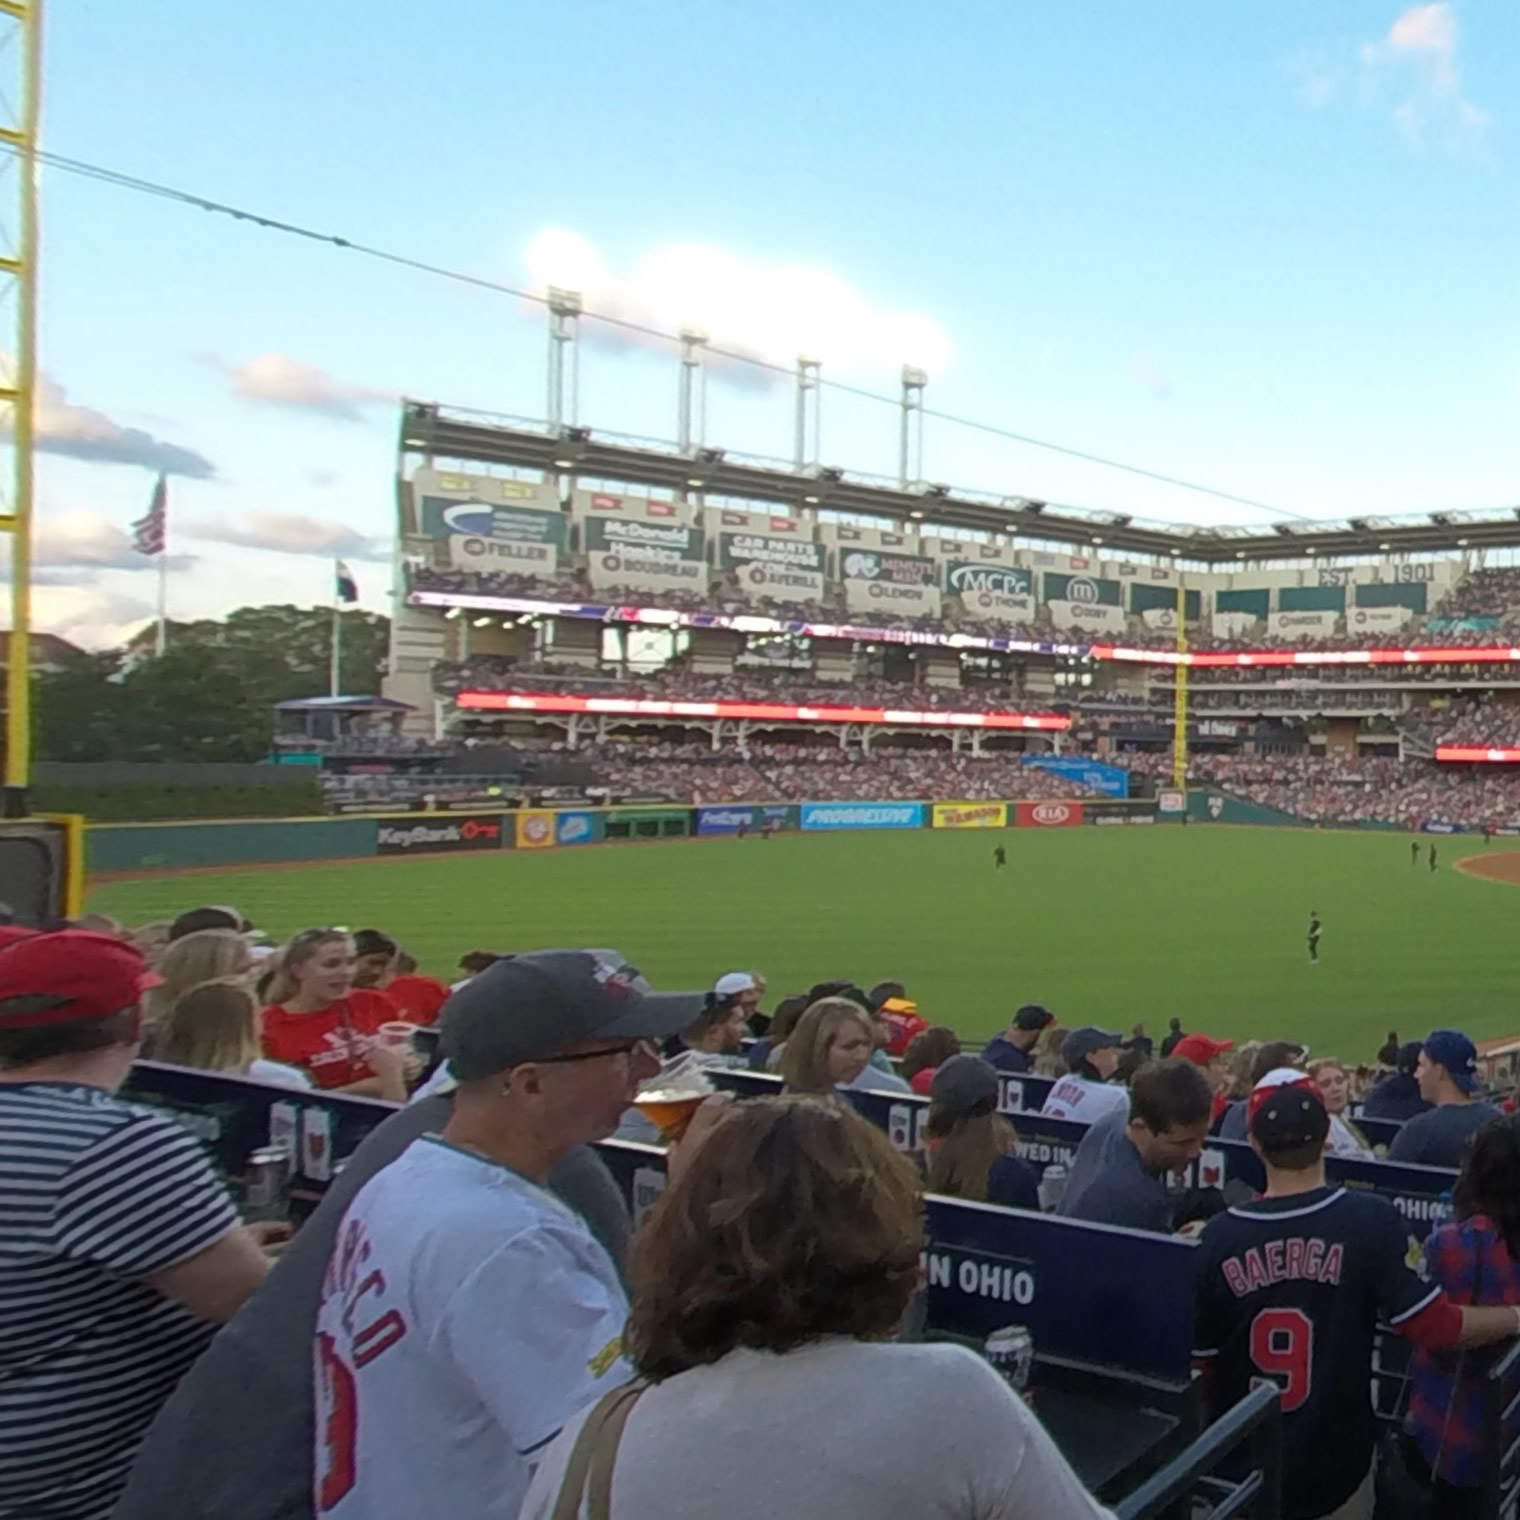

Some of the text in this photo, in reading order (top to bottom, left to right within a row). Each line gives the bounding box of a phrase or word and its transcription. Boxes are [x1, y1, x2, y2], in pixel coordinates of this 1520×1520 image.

[733, 535, 816, 556] CAR PARTS
[1393, 563, 1435, 583] 1901
[377, 827, 461, 846] KeyBank
[958, 1260, 1034, 1305] OHIO
[1221, 1237, 1344, 1297] BAERGA
[1250, 1308, 1313, 1412] 9
